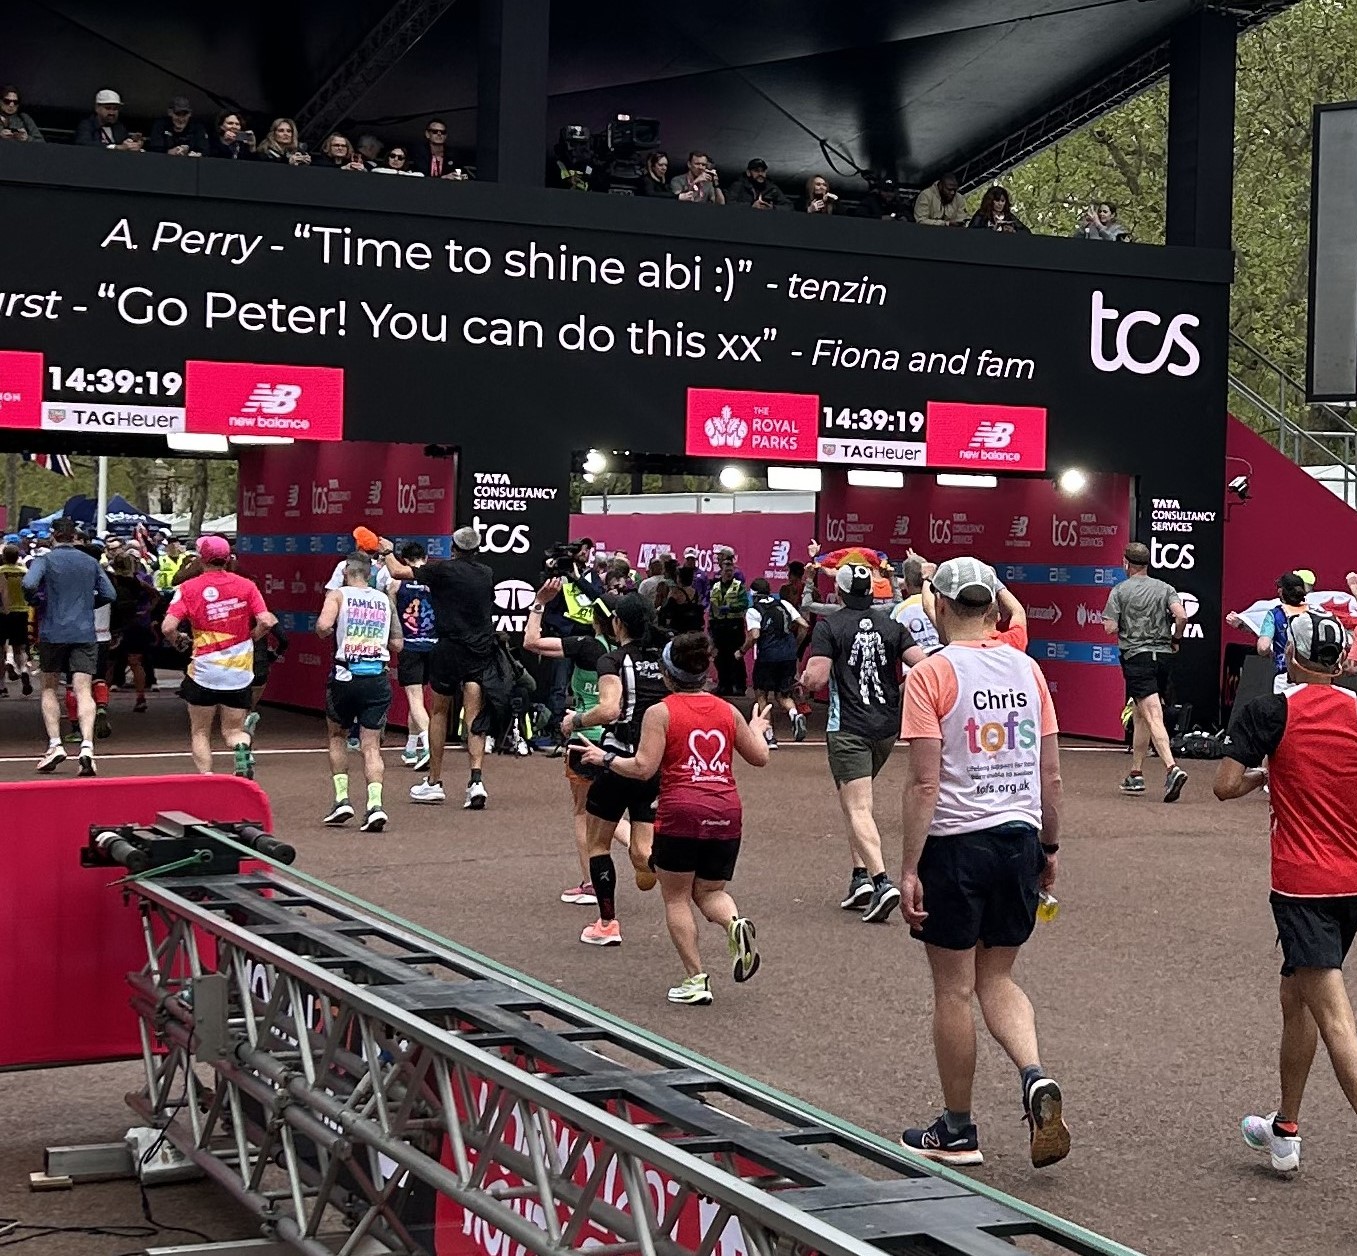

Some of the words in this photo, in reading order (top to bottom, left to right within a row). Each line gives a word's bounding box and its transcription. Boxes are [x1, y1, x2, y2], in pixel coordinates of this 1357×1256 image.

[101, 219, 137, 249] A.
[152, 222, 262, 264] Perry
[445, 240, 491, 274] to
[505, 242, 624, 284] shine
[639, 253, 701, 290] abi
[789, 274, 886, 305] tenzin
[207, 292, 345, 336] Peter!
[361, 302, 446, 342] You
[464, 317, 542, 347] can
[559, 315, 614, 351] do
[627, 320, 705, 357] this
[812, 340, 899, 370] Fiona
[909, 348, 968, 374] and
[977, 350, 1034, 379] fam
[1091, 291, 1199, 376] tcs
[49, 367, 182, 395] 14:39:19
[753, 406, 770, 415] THE
[824, 407, 924, 432] 14:39:19
[258, 416, 310, 430] balance
[752, 419, 799, 434] ROYAL
[751, 435, 798, 451] PARKS
[981, 450, 1021, 462] balance
[474, 473, 510, 484] TATA
[312, 480, 328, 515] tcs
[398, 477, 416, 514] tcs
[474, 486, 557, 500] CONSULTANCY
[473, 499, 527, 511] SERVICES
[1152, 499, 1180, 509] TATA
[1152, 510, 1216, 521] CONSULTANCY
[473, 515, 531, 554] tcs
[827, 513, 845, 542] tcs
[930, 512, 951, 543] tcs
[1052, 513, 1078, 546] tcs
[1152, 522, 1192, 532] SERVICES
[1151, 537, 1194, 569] tcs
[347, 597, 386, 612] FAMILIES
[492, 615, 531, 632] AT
[973, 689, 1027, 711] Chris
[964, 711, 1036, 754] tofs
[976, 780, 1030, 794] tofs.org.uk
